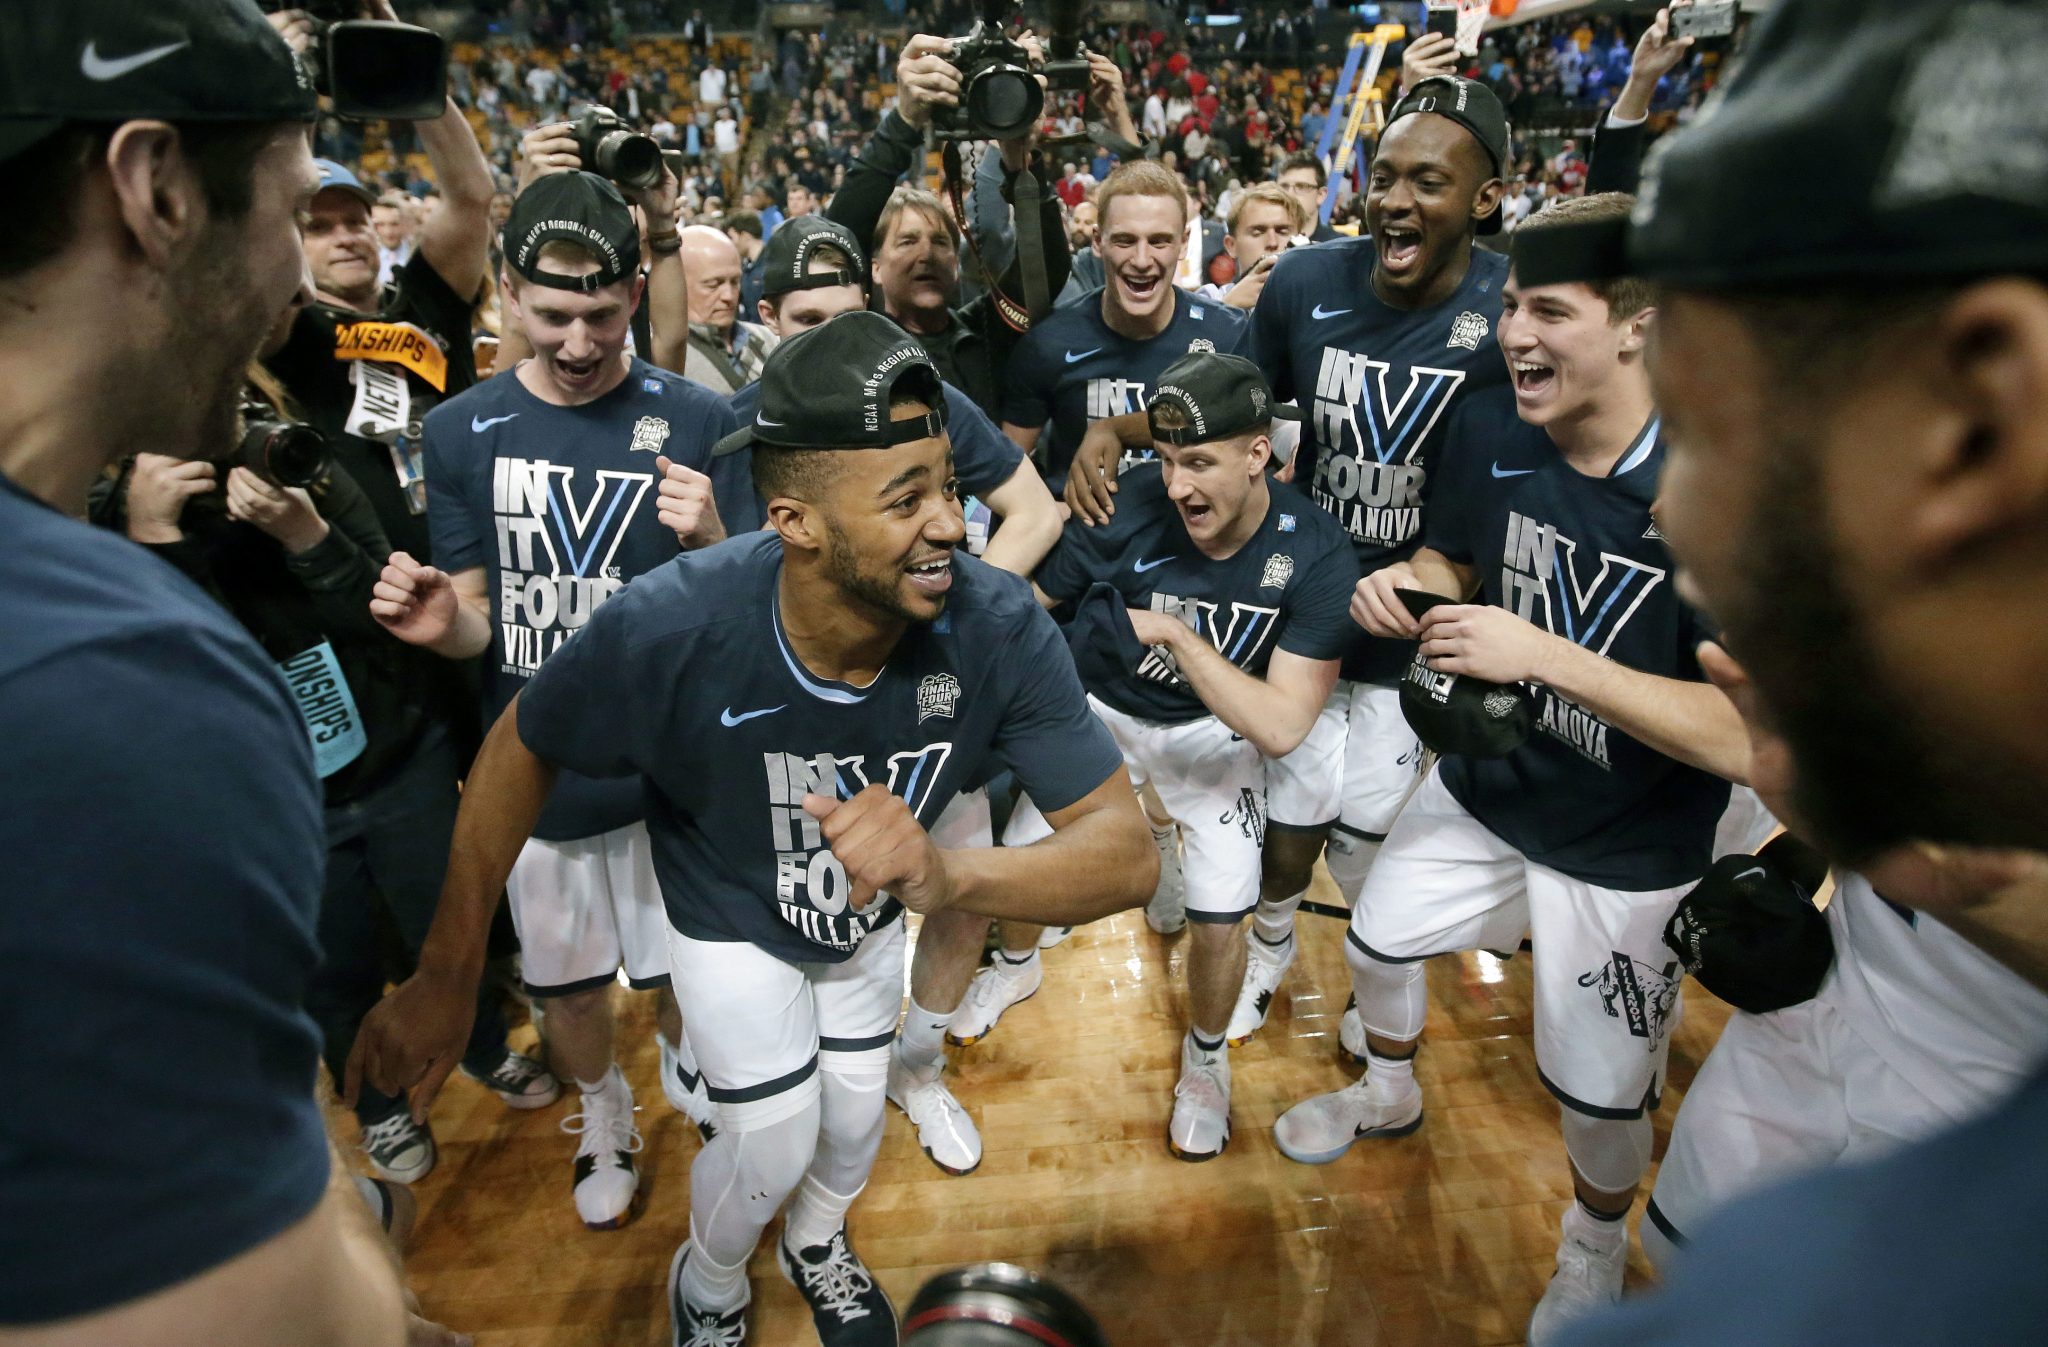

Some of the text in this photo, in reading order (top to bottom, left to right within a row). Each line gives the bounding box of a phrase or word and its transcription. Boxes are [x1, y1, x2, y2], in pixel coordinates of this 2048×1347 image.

[1455, 327, 1479, 340] FOUR
[1456, 318, 1480, 330] FINAL
[864, 403, 879, 432] NCAA
[878, 346, 924, 373] REGIONAL
[1316, 346, 1368, 405] IN
[1087, 378, 1127, 417] IN
[1183, 392, 1207, 435] CHAMPIONS
[636, 423, 663, 433] FINAL
[637, 431, 661, 440] FOUR
[1313, 398, 1353, 452] IT
[493, 457, 549, 515] IN
[494, 515, 542, 572] IT
[1503, 511, 1557, 580] IN
[1266, 560, 1289, 571] FINAL
[1266, 569, 1288, 578] FOUR
[920, 682, 951, 701] FINAL
[922, 692, 953, 708] FOUR
[1431, 691, 1448, 704] 2018
[763, 751, 838, 804] IN
[1619, 960, 1643, 1031] VILLANOVA
